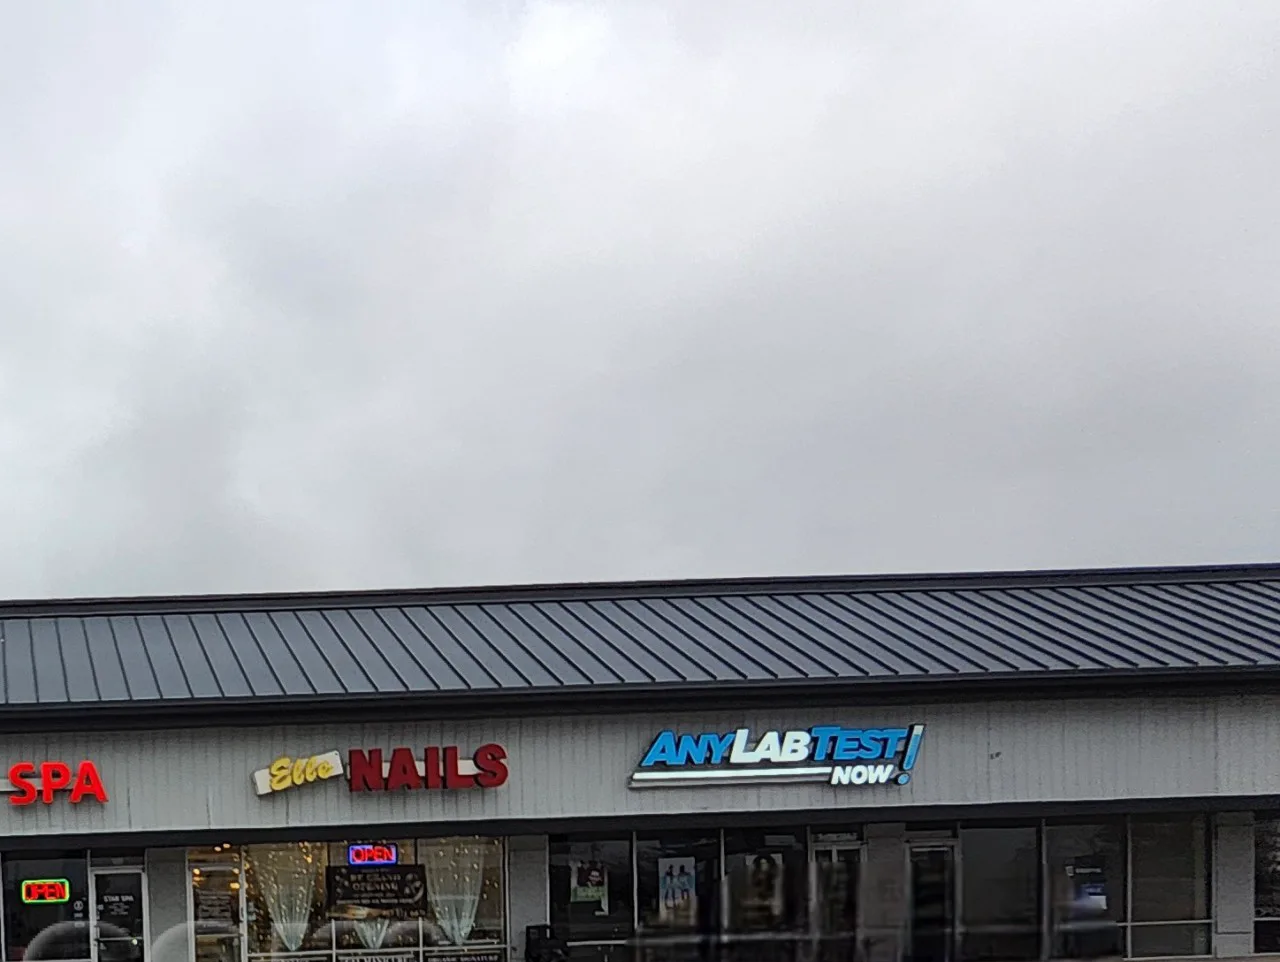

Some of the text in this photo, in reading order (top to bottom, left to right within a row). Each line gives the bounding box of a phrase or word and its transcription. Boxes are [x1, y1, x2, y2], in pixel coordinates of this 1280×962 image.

[349, 743, 508, 792] NAILS
[830, 764, 894, 785] NOW
[9, 760, 108, 804] SPA
[352, 846, 393, 862] OPEN
[25, 882, 66, 900] OPEN
